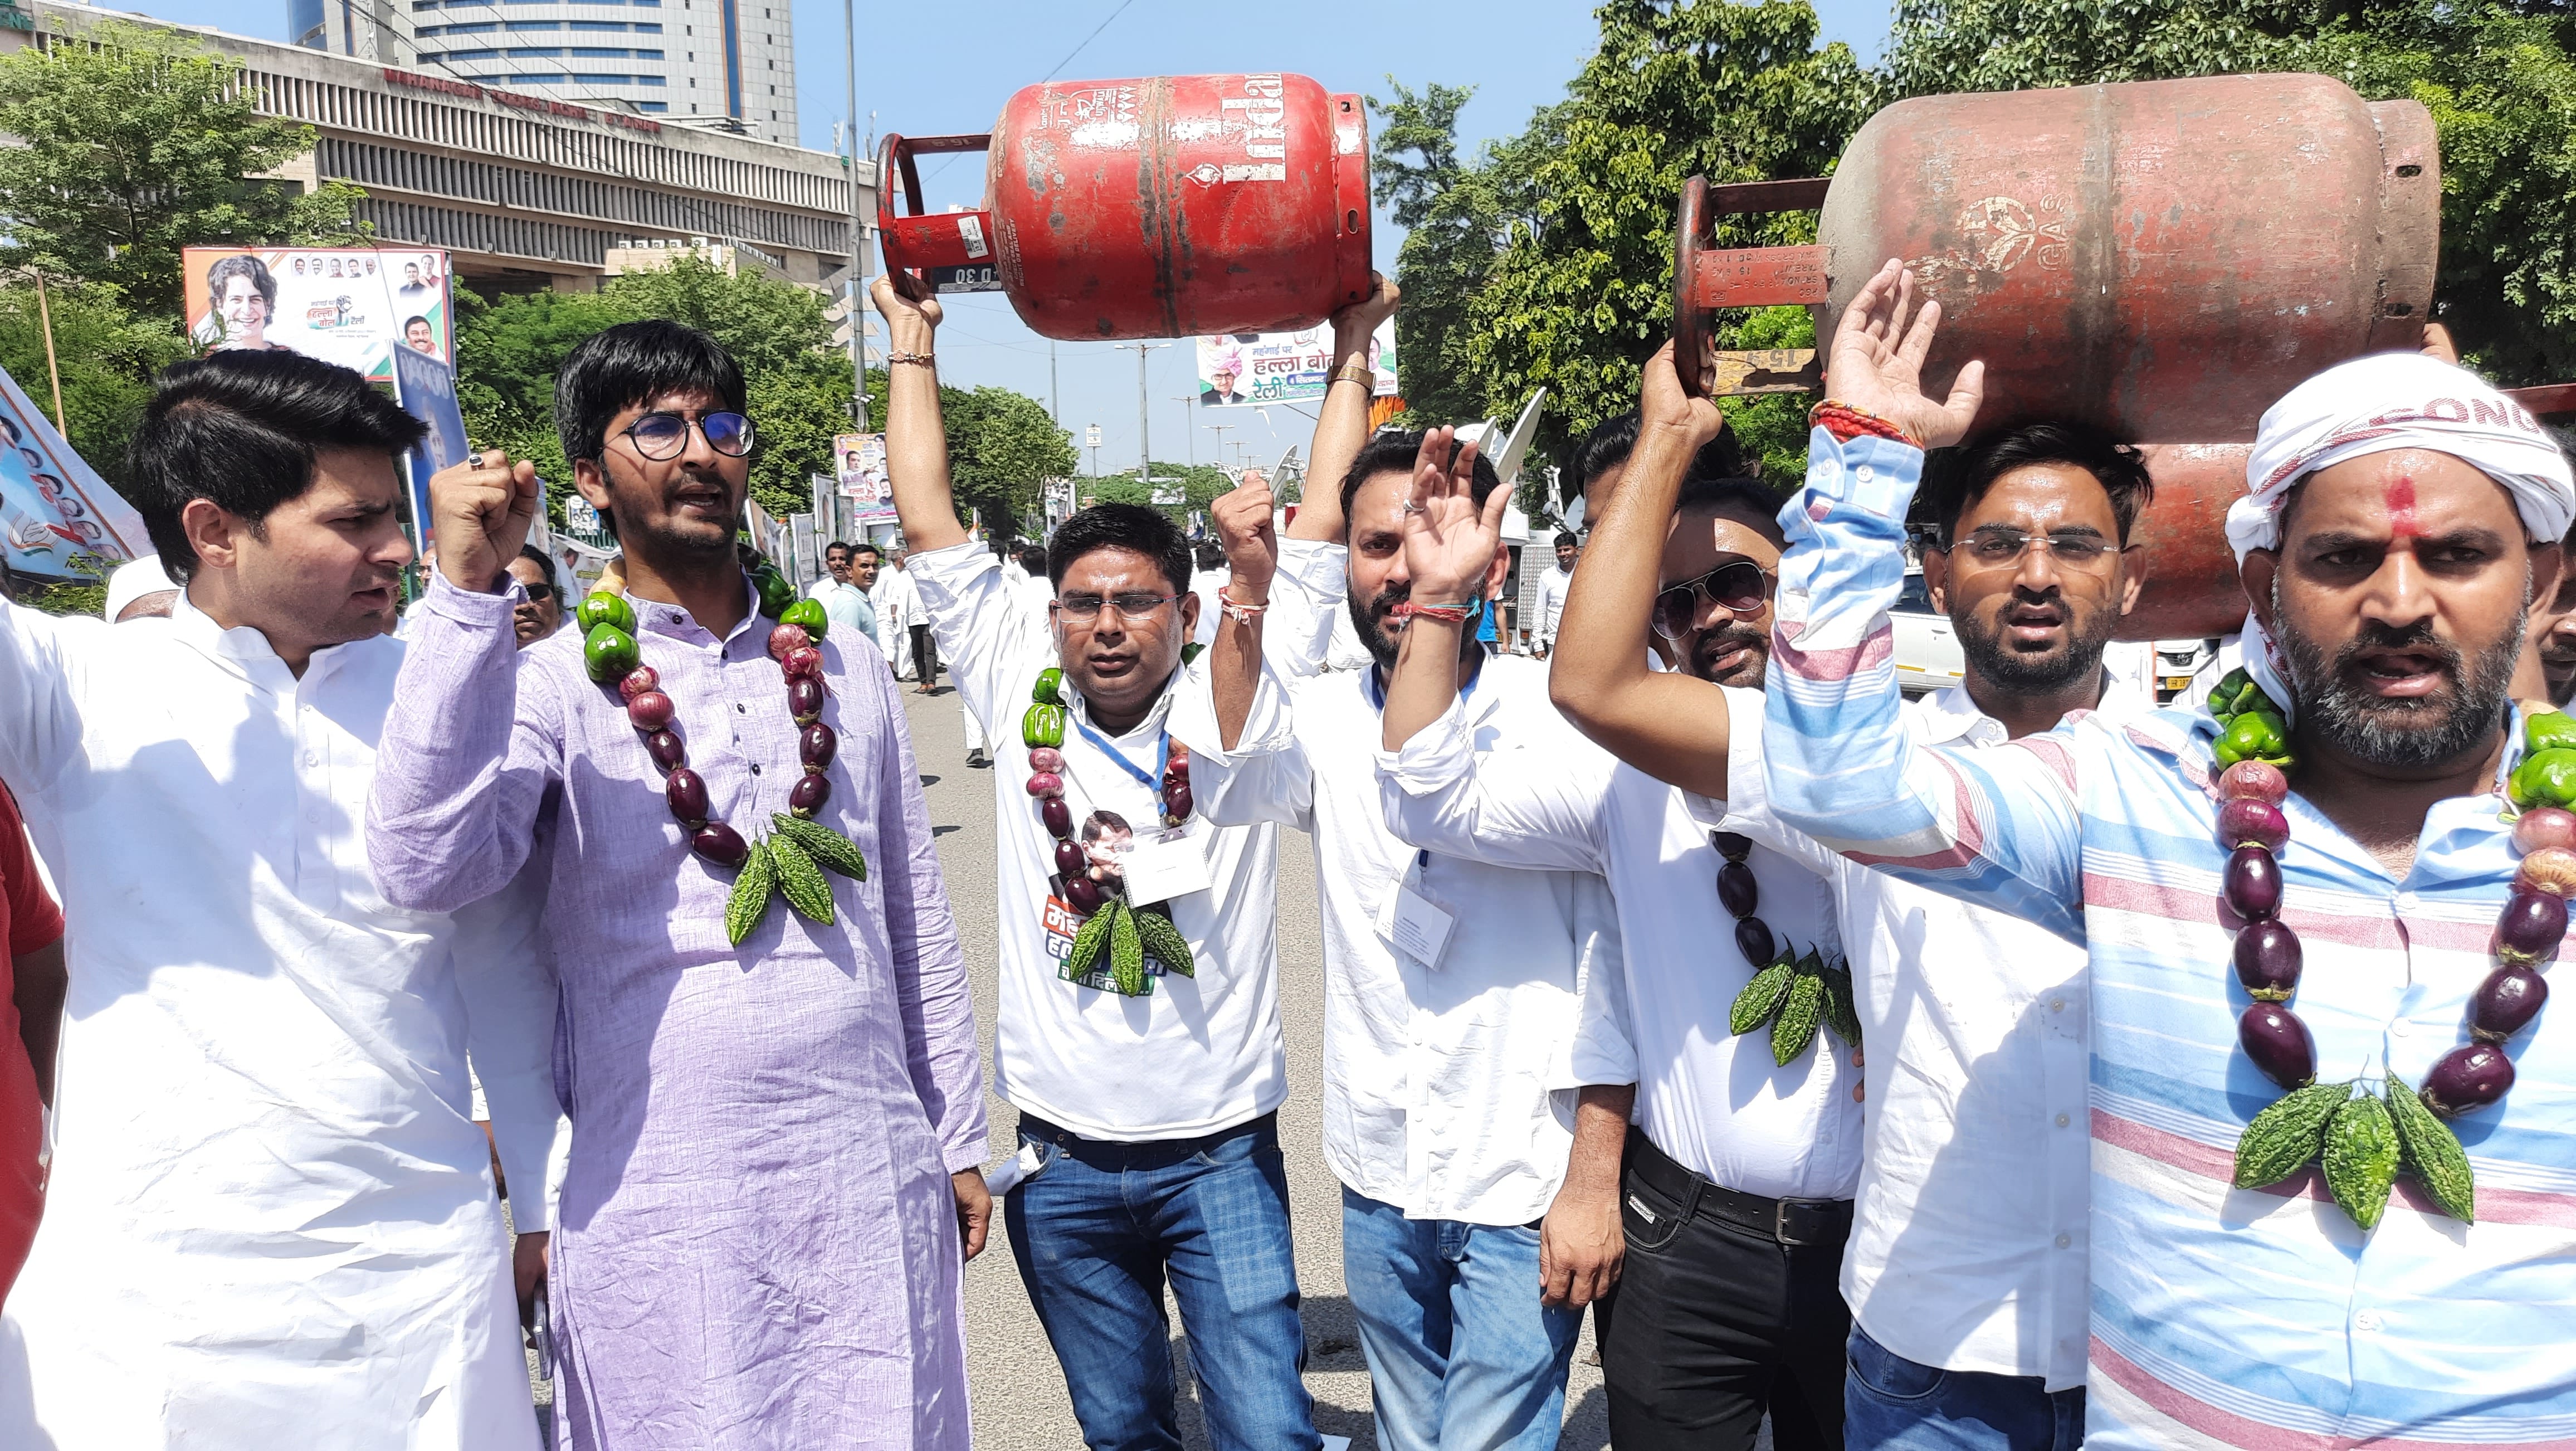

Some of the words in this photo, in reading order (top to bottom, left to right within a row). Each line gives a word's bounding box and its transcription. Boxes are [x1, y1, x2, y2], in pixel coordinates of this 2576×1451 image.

[955, 268, 975, 284] 30
[1252, 343, 1280, 357] महंगाई
[1282, 345, 1292, 354] पर
[1769, 350, 1797, 367] 15
[1252, 356, 1302, 375] हल्ला
[1252, 376, 1283, 399] रैली
